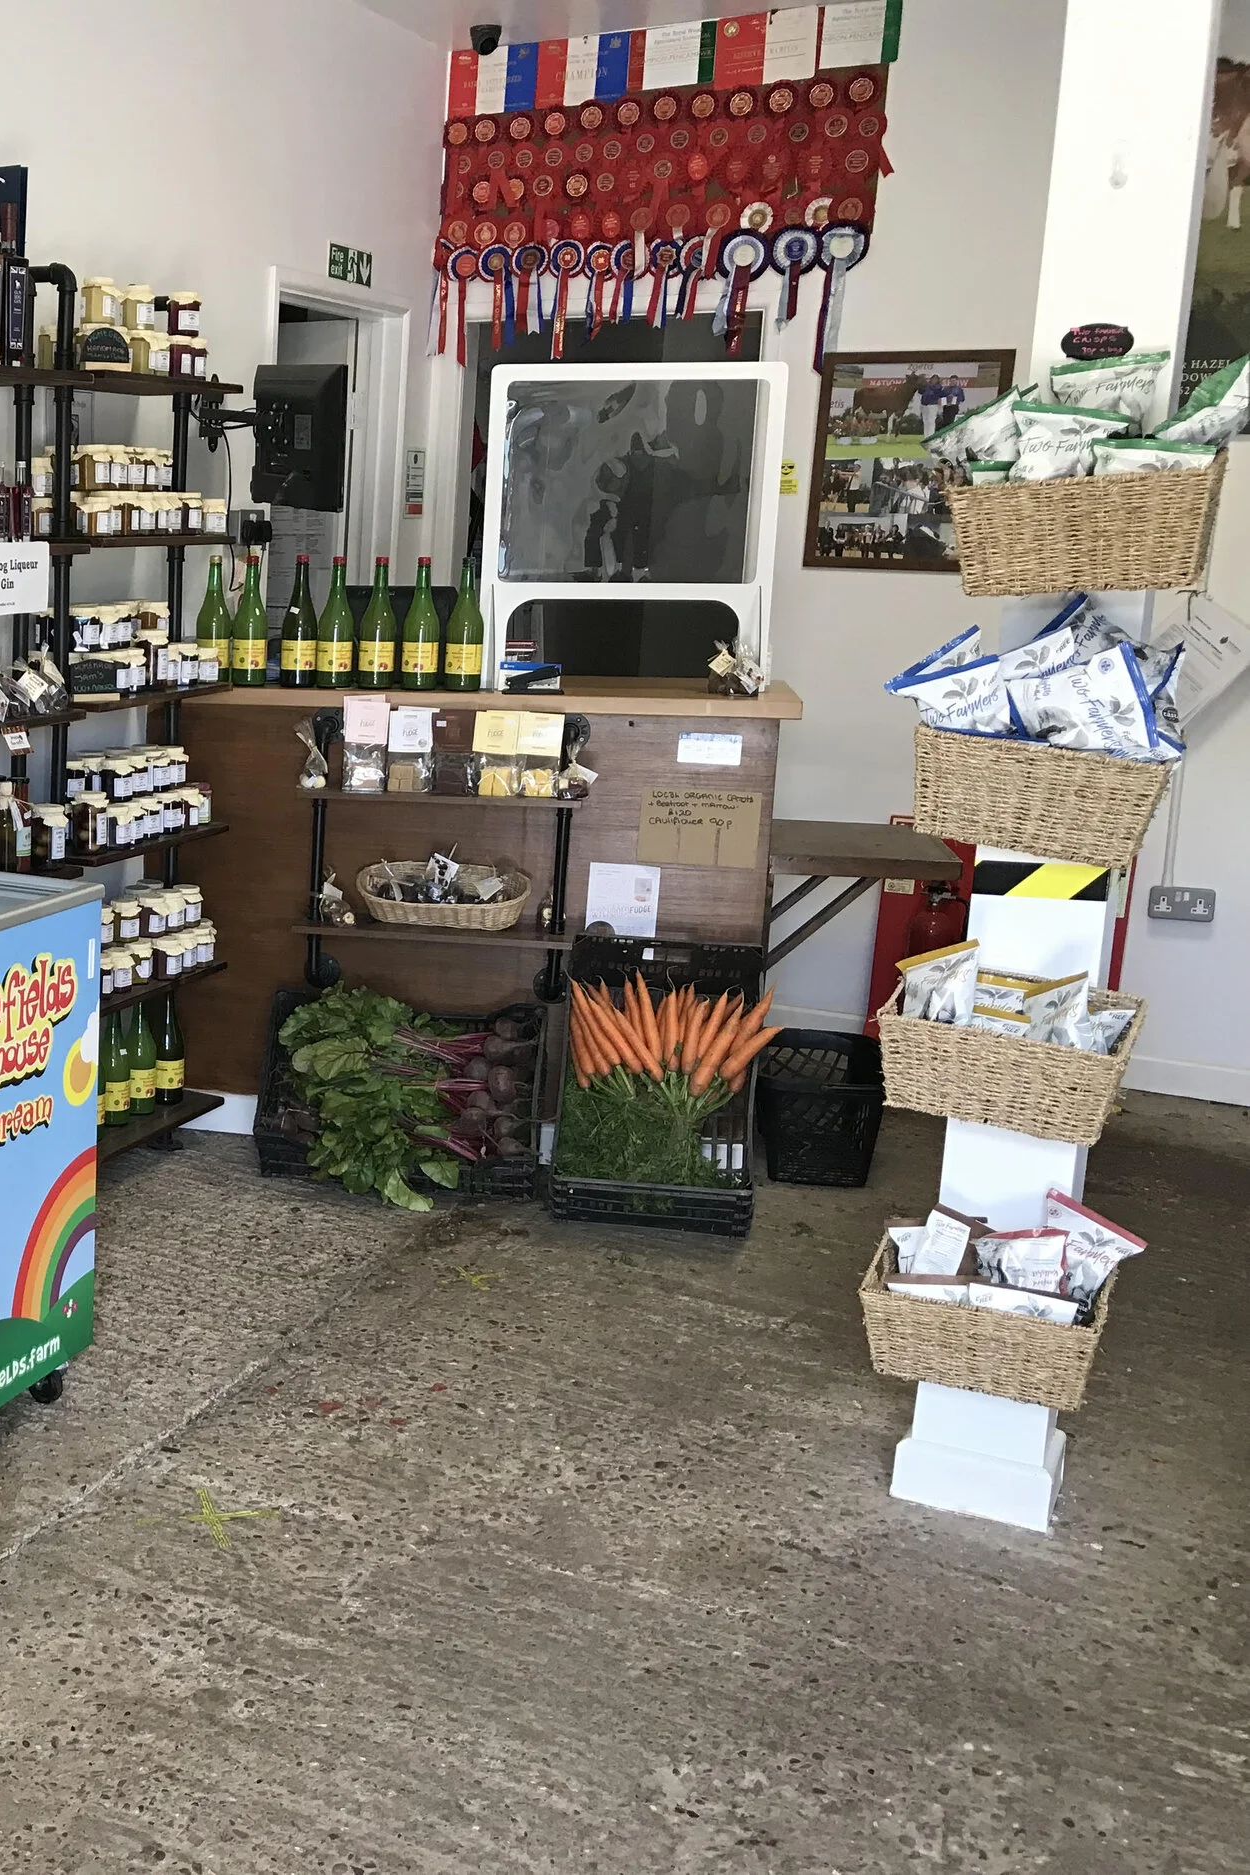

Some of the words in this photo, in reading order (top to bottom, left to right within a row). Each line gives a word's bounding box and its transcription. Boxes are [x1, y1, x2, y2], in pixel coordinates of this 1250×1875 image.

[332, 247, 344, 262] Fire
[331, 263, 342, 276] exit
[1021, 438, 1051, 454] Two
[10, 559, 38, 572] Liqueur
[1, 579, 14, 589] Gin
[1068, 669, 1088, 700] Two
[921, 706, 944, 726] Two
[946, 691, 998, 718] Farmers
[402, 728, 418, 737] FUDGE
[487, 729, 504, 737] FUDGE
